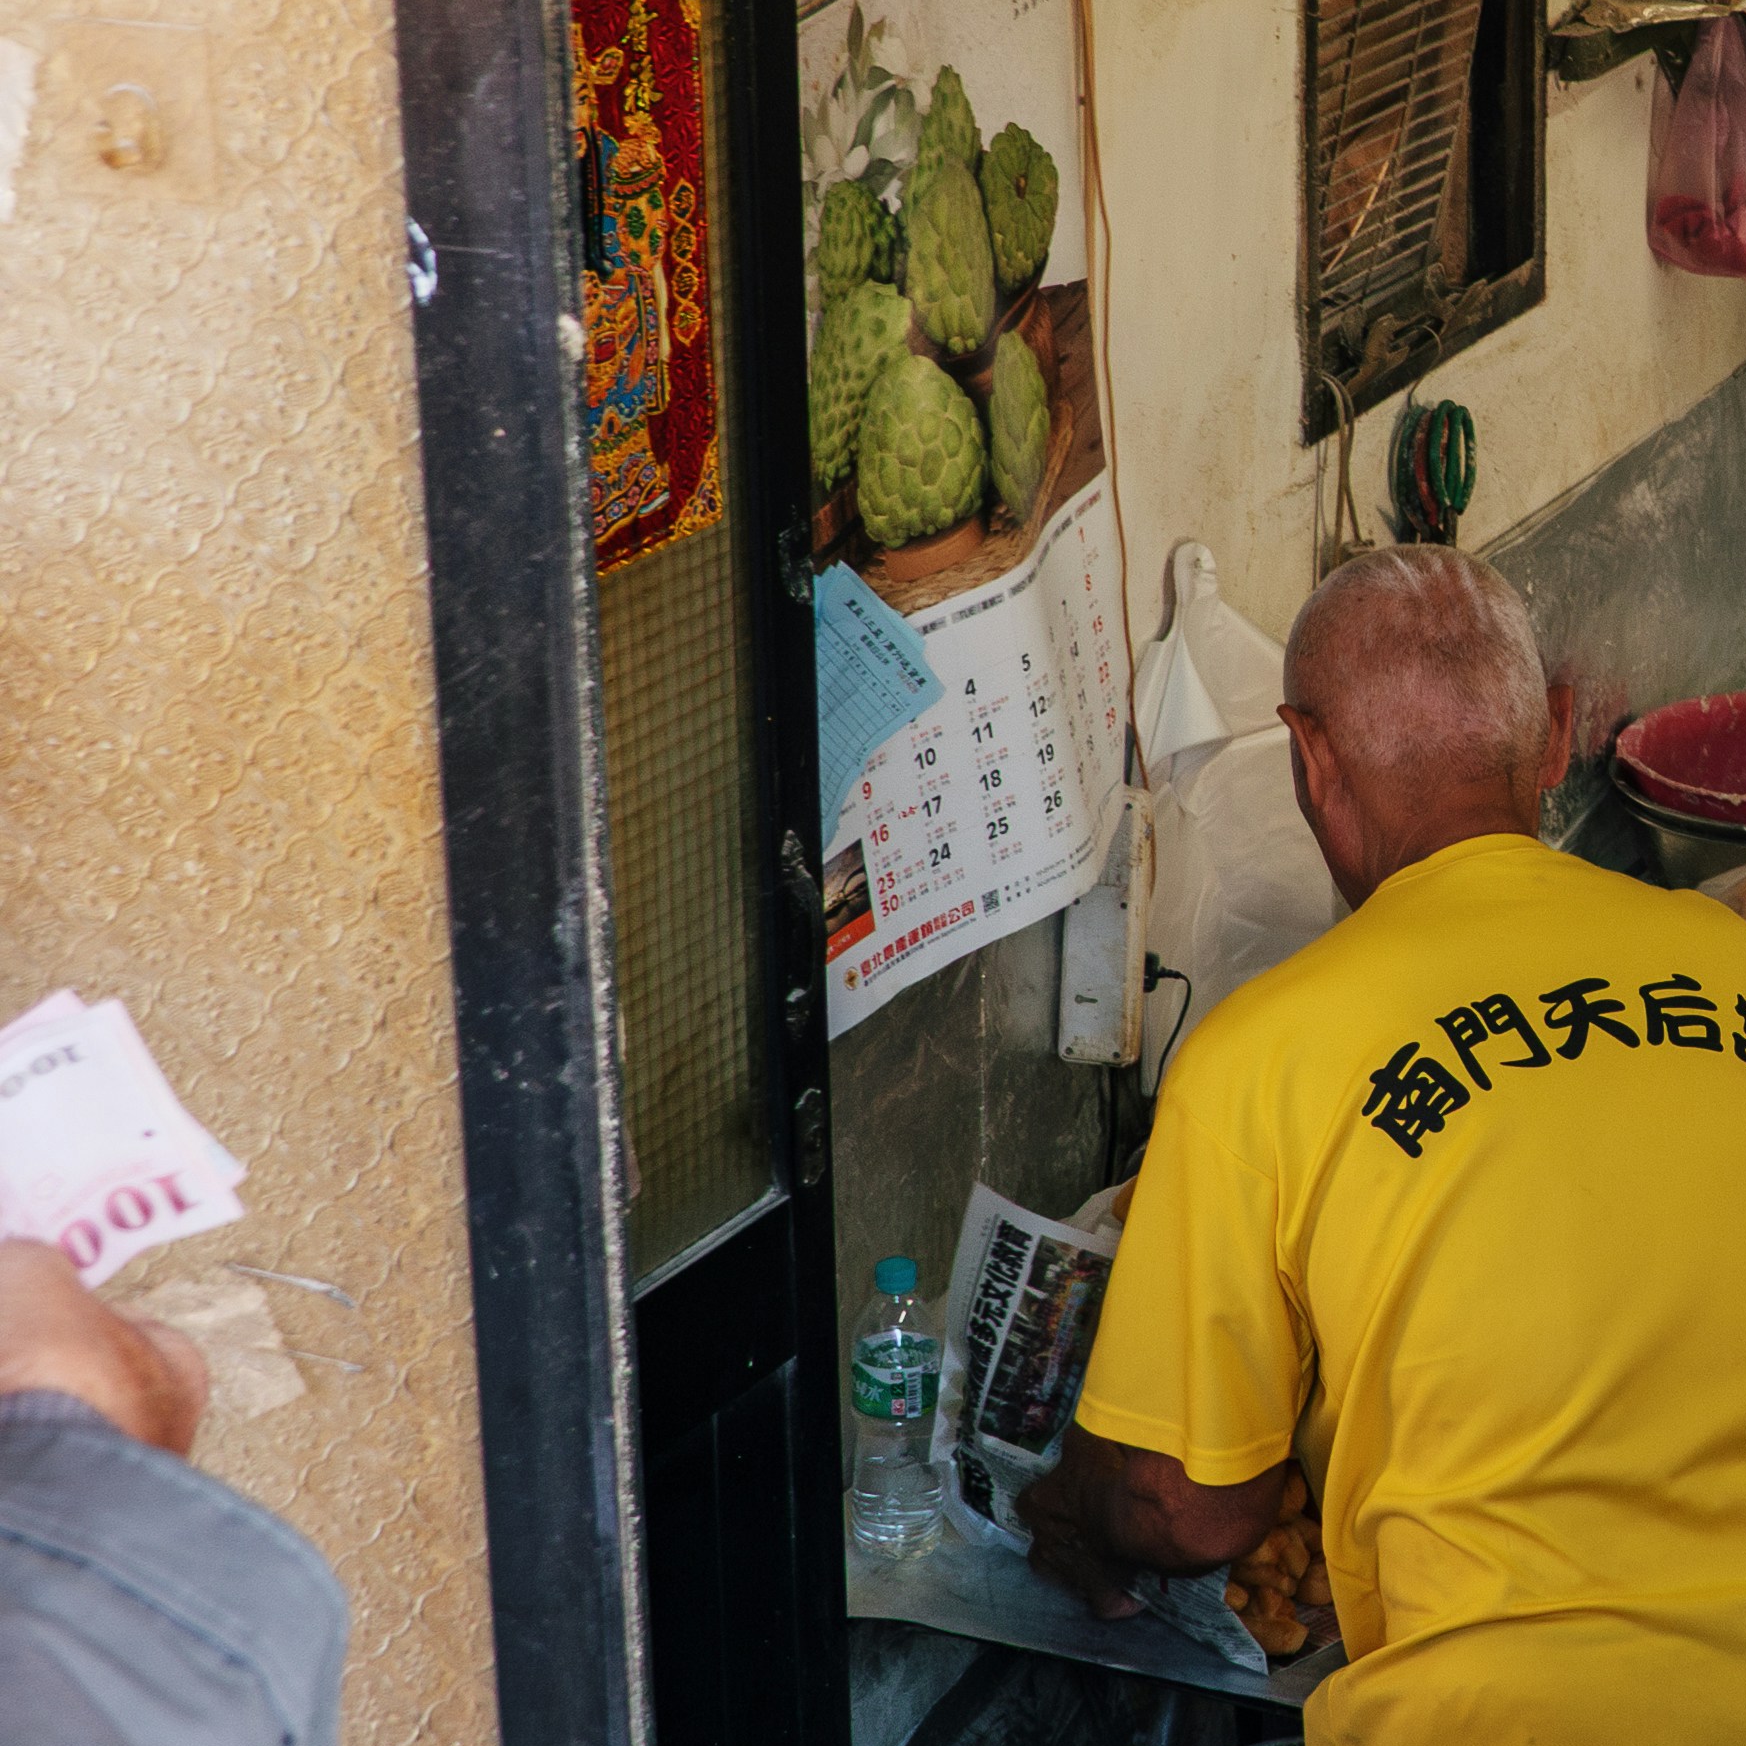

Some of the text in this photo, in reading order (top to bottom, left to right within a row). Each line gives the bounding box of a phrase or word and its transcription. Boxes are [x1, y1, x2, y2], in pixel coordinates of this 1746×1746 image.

[1021, 653, 1031, 672] 5
[964, 679, 976, 695] 4
[1029, 696, 1048, 718] 12
[971, 722, 994, 743] 11
[914, 748, 937, 769] 10
[1036, 743, 1055, 765] 19
[862, 781, 872, 800] 9
[979, 769, 1002, 791] 18
[922, 795, 942, 818] 17
[1043, 790, 1063, 814] 26
[870, 824, 890, 846] 16
[986, 817, 1009, 840] 25
[929, 843, 952, 867] 24
[877, 871, 896, 895] 23
[880, 896, 900, 918] 30
[58, 1171, 200, 1270] 100
